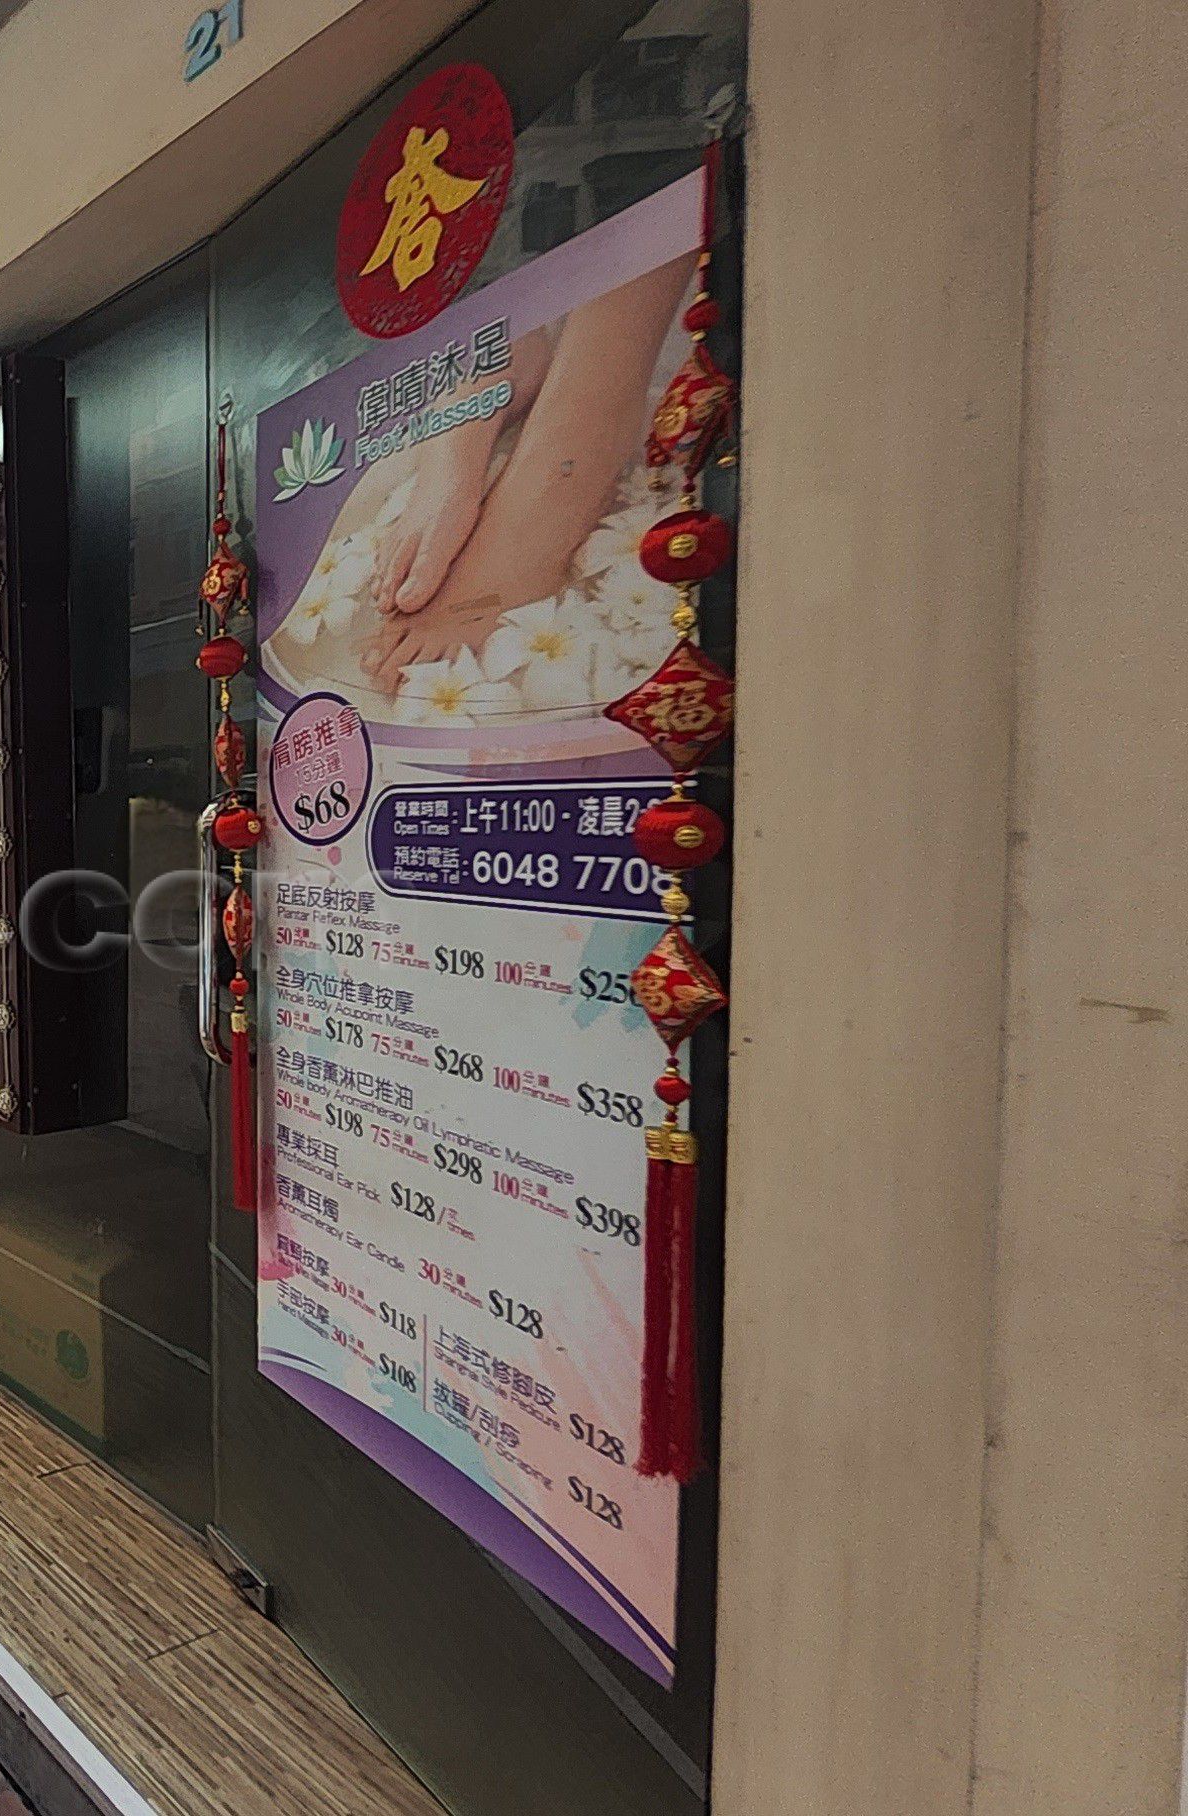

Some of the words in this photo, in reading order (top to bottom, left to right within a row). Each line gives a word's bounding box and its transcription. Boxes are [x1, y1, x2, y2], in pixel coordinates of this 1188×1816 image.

[357, 315, 510, 434] 偉晴沐足
[355, 422, 404, 467] Foot
[409, 379, 511, 448] Massage
[293, 780, 351, 834] $68
[395, 821, 417, 834] Open
[461, 798, 553, 833] 上午11:00
[277, 884, 374, 913] 足底反射按摩
[442, 870, 458, 883] Tel
[473, 852, 558, 887] 6048
[573, 856, 671, 894] 7708
[277, 926, 291, 943] 50
[326, 929, 363, 957] $128
[372, 940, 390, 960] 75
[436, 943, 484, 977] $198
[495, 959, 522, 985] 100
[578, 965, 645, 1007] $25
[277, 966, 413, 1015] 全身穴位推拿按摩
[277, 1009, 291, 1027] 50
[326, 1017, 362, 1048] $178
[371, 1033, 389, 1055] 75
[435, 1043, 482, 1082] $268
[493, 1065, 520, 1094] 100
[576, 1080, 643, 1129] $358
[277, 1045, 412, 1110] 全身香薰淋巴推油
[277, 1090, 291, 1110] 50
[326, 1103, 362, 1138] $198
[371, 1124, 389, 1148] 75
[434, 1141, 481, 1184] $298
[492, 1169, 519, 1201] 100
[575, 1193, 640, 1248] $398
[390, 1180, 434, 1223] $128
[332, 1277, 345, 1298] 30
[380, 1300, 416, 1341] $118
[418, 1257, 440, 1286] 30
[489, 1287, 543, 1342] $128
[332, 1325, 345, 1347] 30
[380, 1352, 415, 1395] $108
[569, 1410, 625, 1467] $128
[568, 1473, 623, 1533] $128
